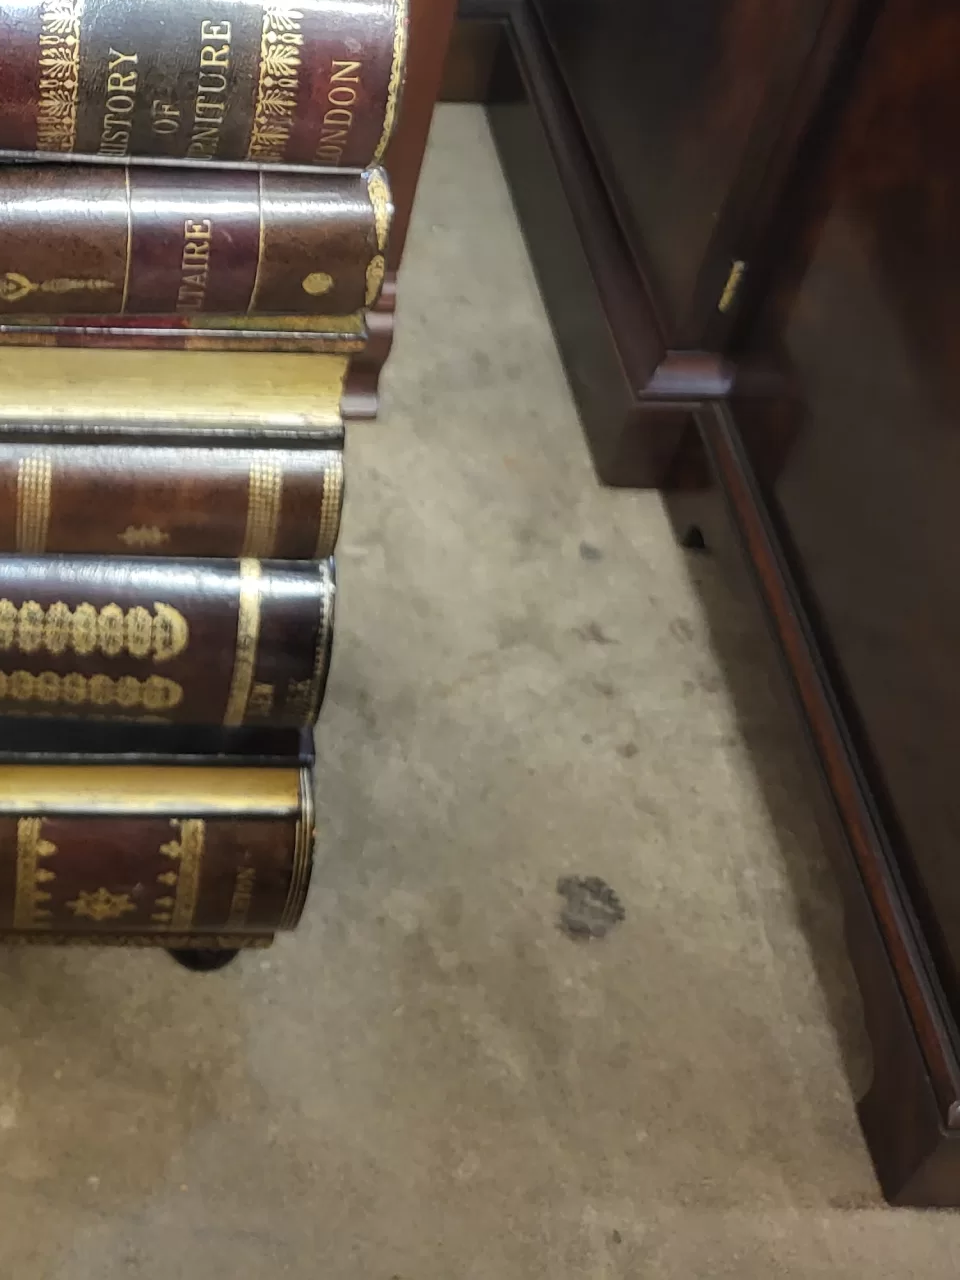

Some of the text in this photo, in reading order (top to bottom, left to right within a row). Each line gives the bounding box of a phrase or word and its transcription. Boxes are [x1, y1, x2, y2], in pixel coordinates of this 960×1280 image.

[97, 47, 139, 157] HISTORY
[152, 99, 181, 136] OF
[186, 19, 232, 162] URNITURE
[314, 59, 362, 166] LONDON
[176, 219, 212, 310] LTAIRE
